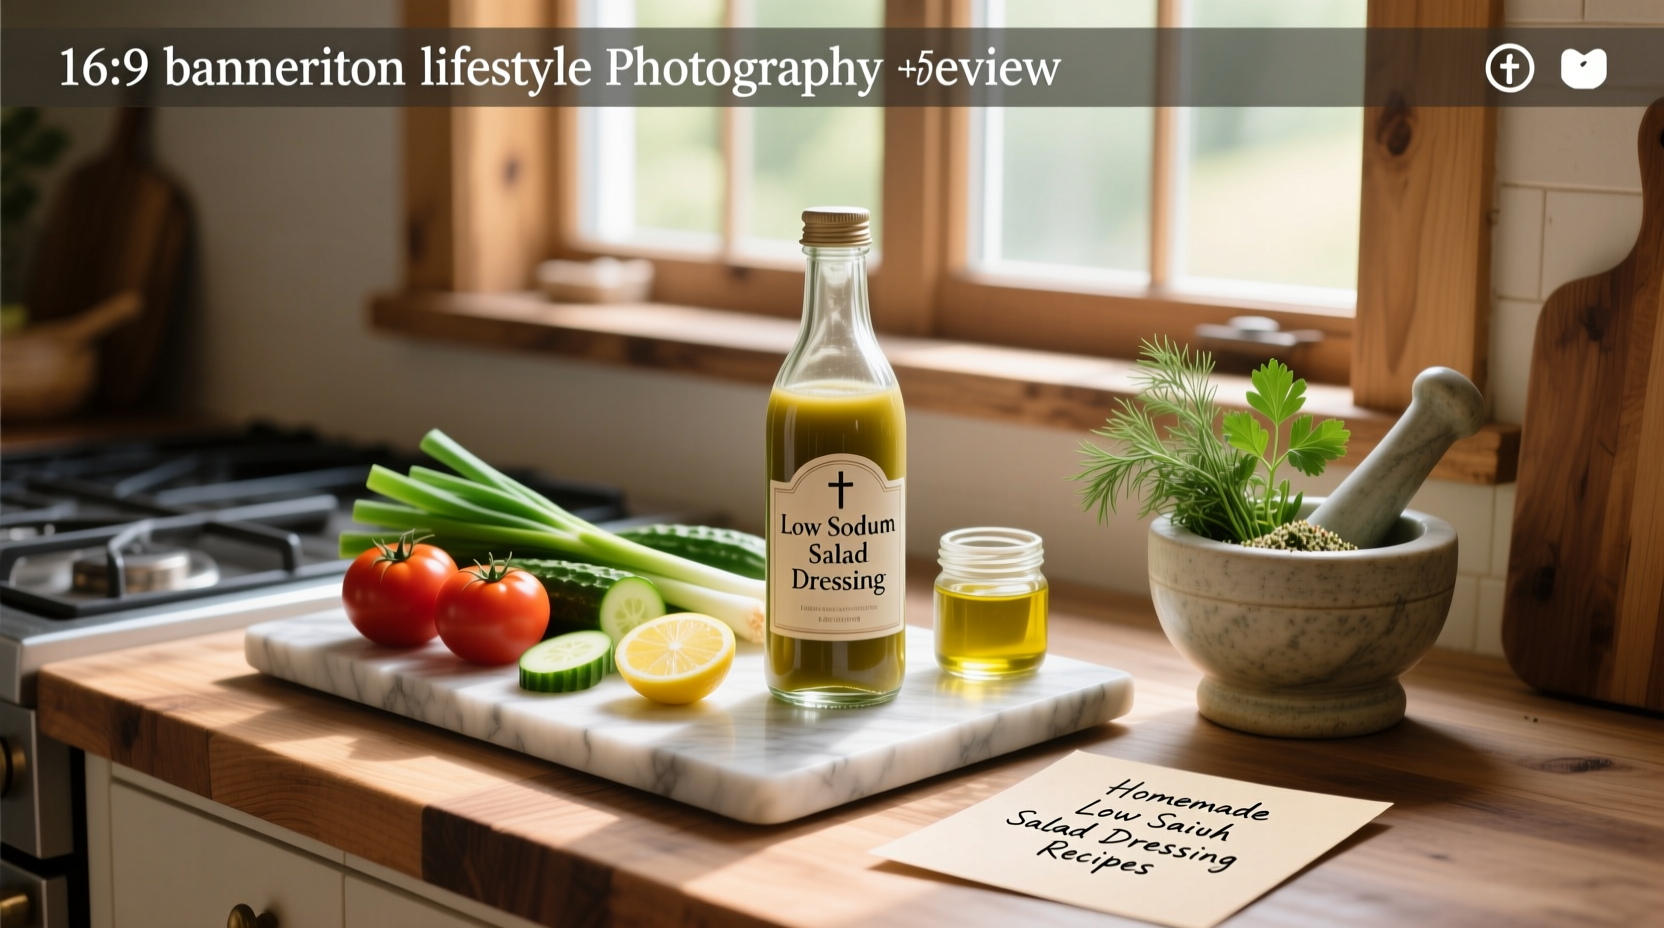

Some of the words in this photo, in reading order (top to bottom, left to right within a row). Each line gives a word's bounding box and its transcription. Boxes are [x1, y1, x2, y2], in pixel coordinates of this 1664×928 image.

[780, 512, 822, 537] Low
[827, 513, 896, 537] Sodum
[808, 541, 868, 565] Salad
[791, 567, 887, 596] Dressing
[1074, 798, 1142, 822] Low
[1105, 778, 1270, 821] Homemade
[1006, 810, 1099, 839] Salad
[1098, 828, 1237, 874] Dressing
[1036, 840, 1155, 875] Recipes
